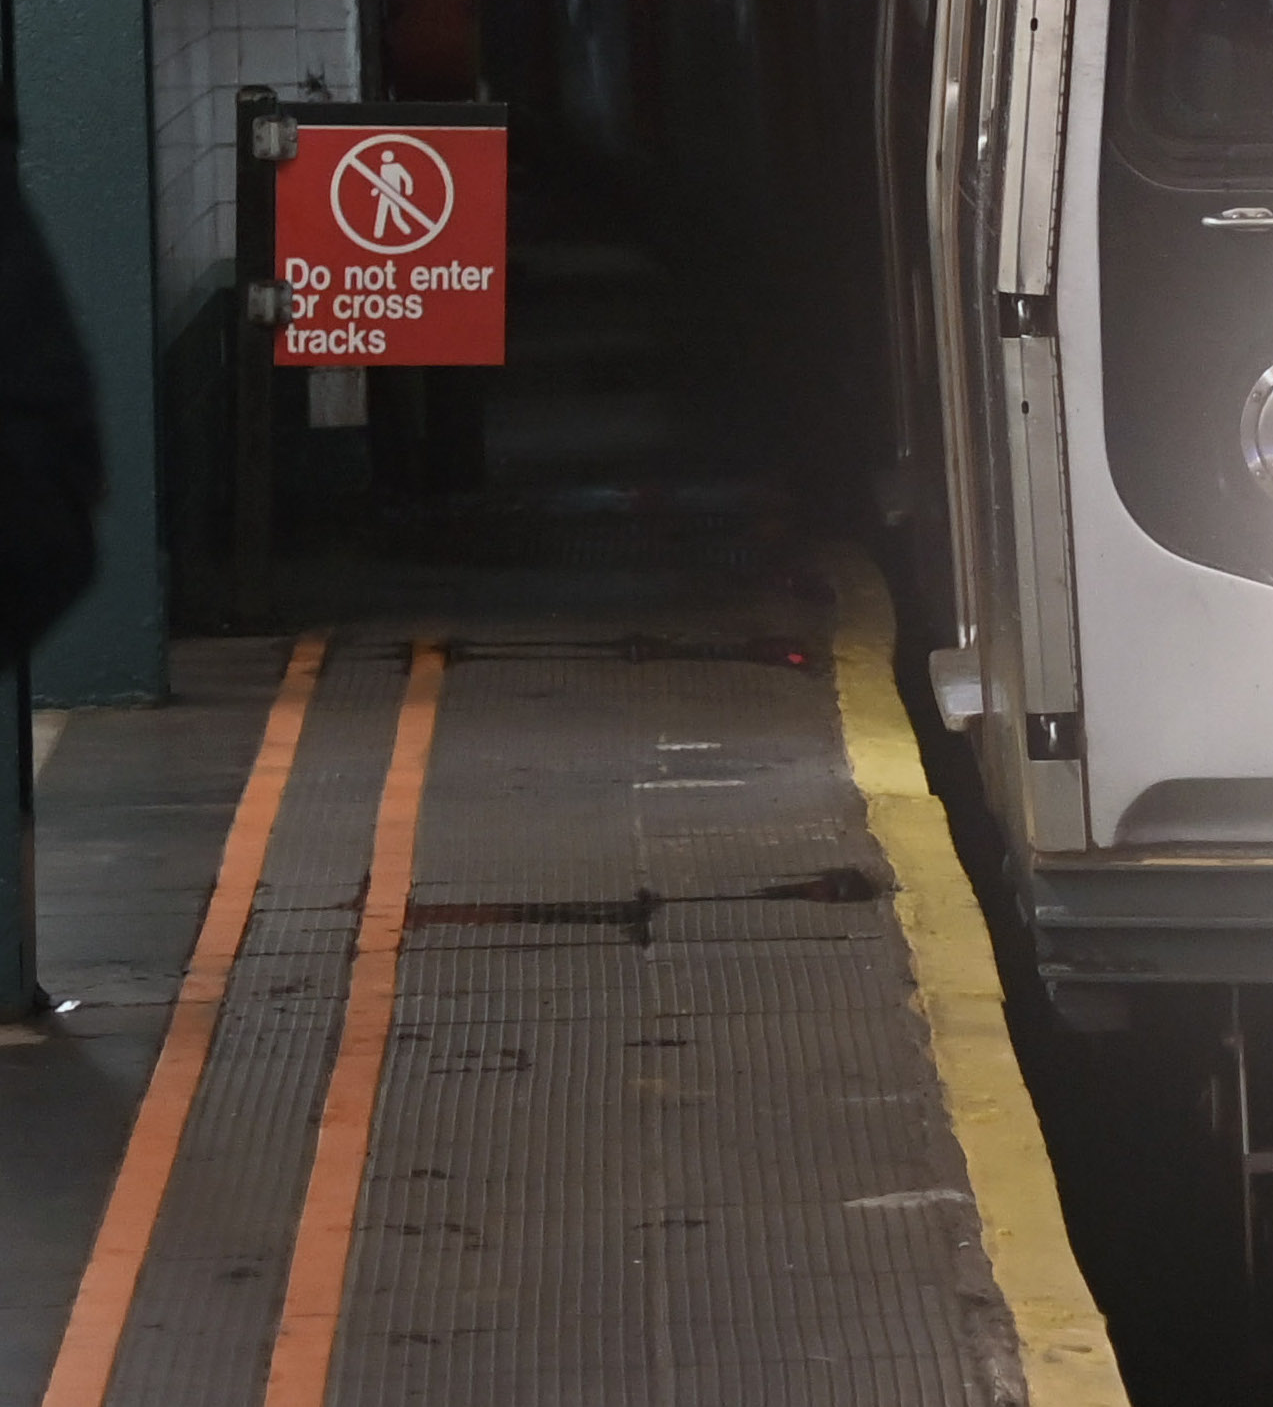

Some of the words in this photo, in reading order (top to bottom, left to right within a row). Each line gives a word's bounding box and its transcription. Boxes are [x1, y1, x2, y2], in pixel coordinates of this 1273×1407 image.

[285, 257, 331, 290] Do
[344, 259, 397, 290] not
[410, 260, 494, 290] enter
[291, 294, 319, 319] or
[333, 294, 423, 319] cross
[285, 322, 387, 354] tracks
